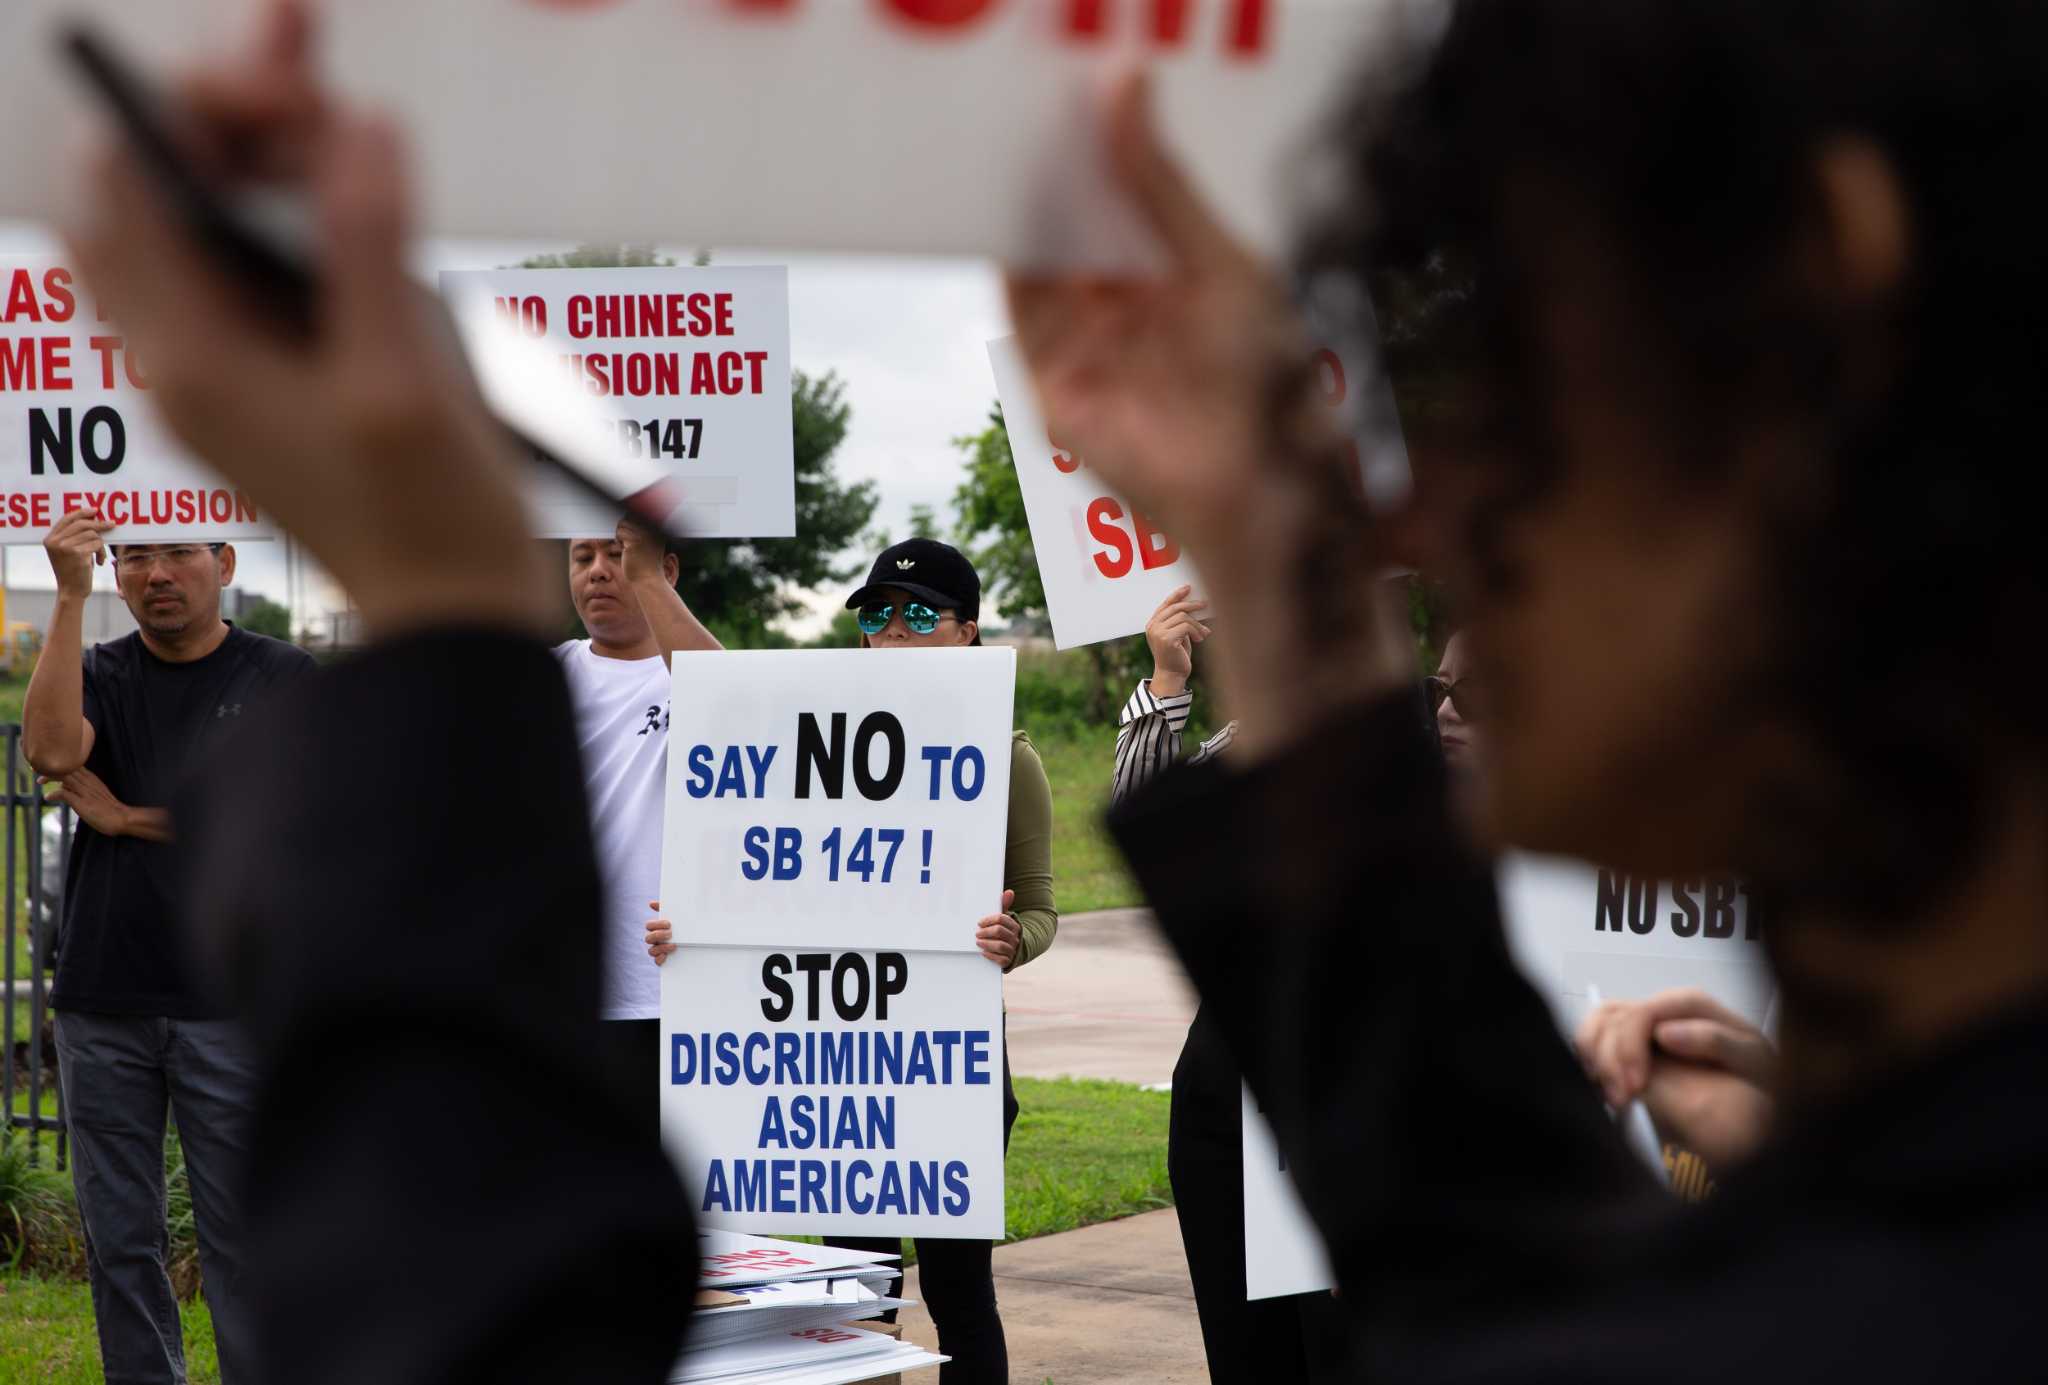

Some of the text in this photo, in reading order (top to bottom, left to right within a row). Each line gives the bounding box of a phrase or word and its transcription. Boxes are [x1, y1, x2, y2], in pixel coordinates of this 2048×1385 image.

[0, 267, 76, 323] AS
[567, 293, 735, 339] CHINESE
[0, 336, 73, 391] ME
[690, 351, 768, 396] ACT
[28, 405, 126, 475] NO
[606, 418, 703, 460] B147
[63, 488, 257, 526] EXCLUSION
[686, 710, 986, 801] SAY NO TO
[741, 825, 802, 881] SB
[821, 826, 904, 883] 147
[1595, 868, 1762, 941] NO SB1
[760, 951, 908, 1022] STOP
[671, 1030, 991, 1086] DISCRIMINATE
[757, 1095, 895, 1149] ASIAN
[701, 1158, 971, 1217] AMERICANS
